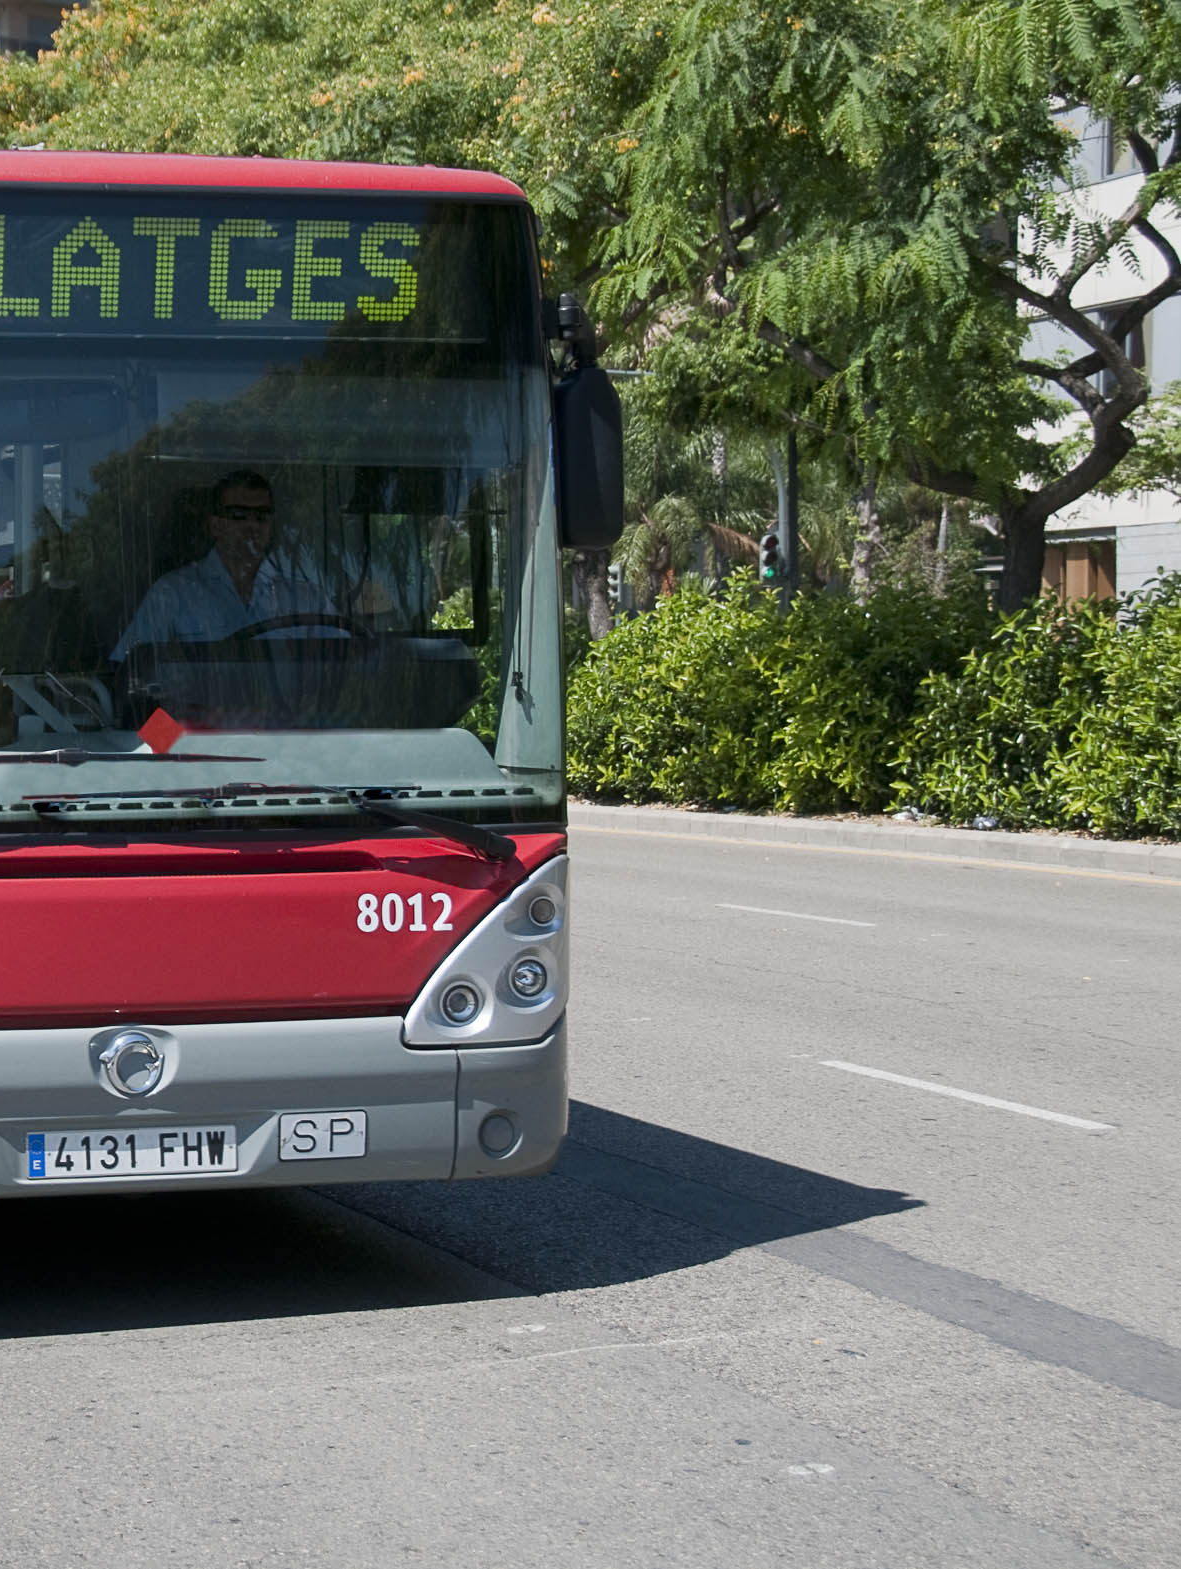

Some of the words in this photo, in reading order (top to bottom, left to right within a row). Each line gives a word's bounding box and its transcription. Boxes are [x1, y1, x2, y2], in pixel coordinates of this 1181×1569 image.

[357, 892, 453, 932] 8012
[32, 1159, 41, 1170] E
[54, 1133, 137, 1171] 4131
[159, 1130, 225, 1167] FHW
